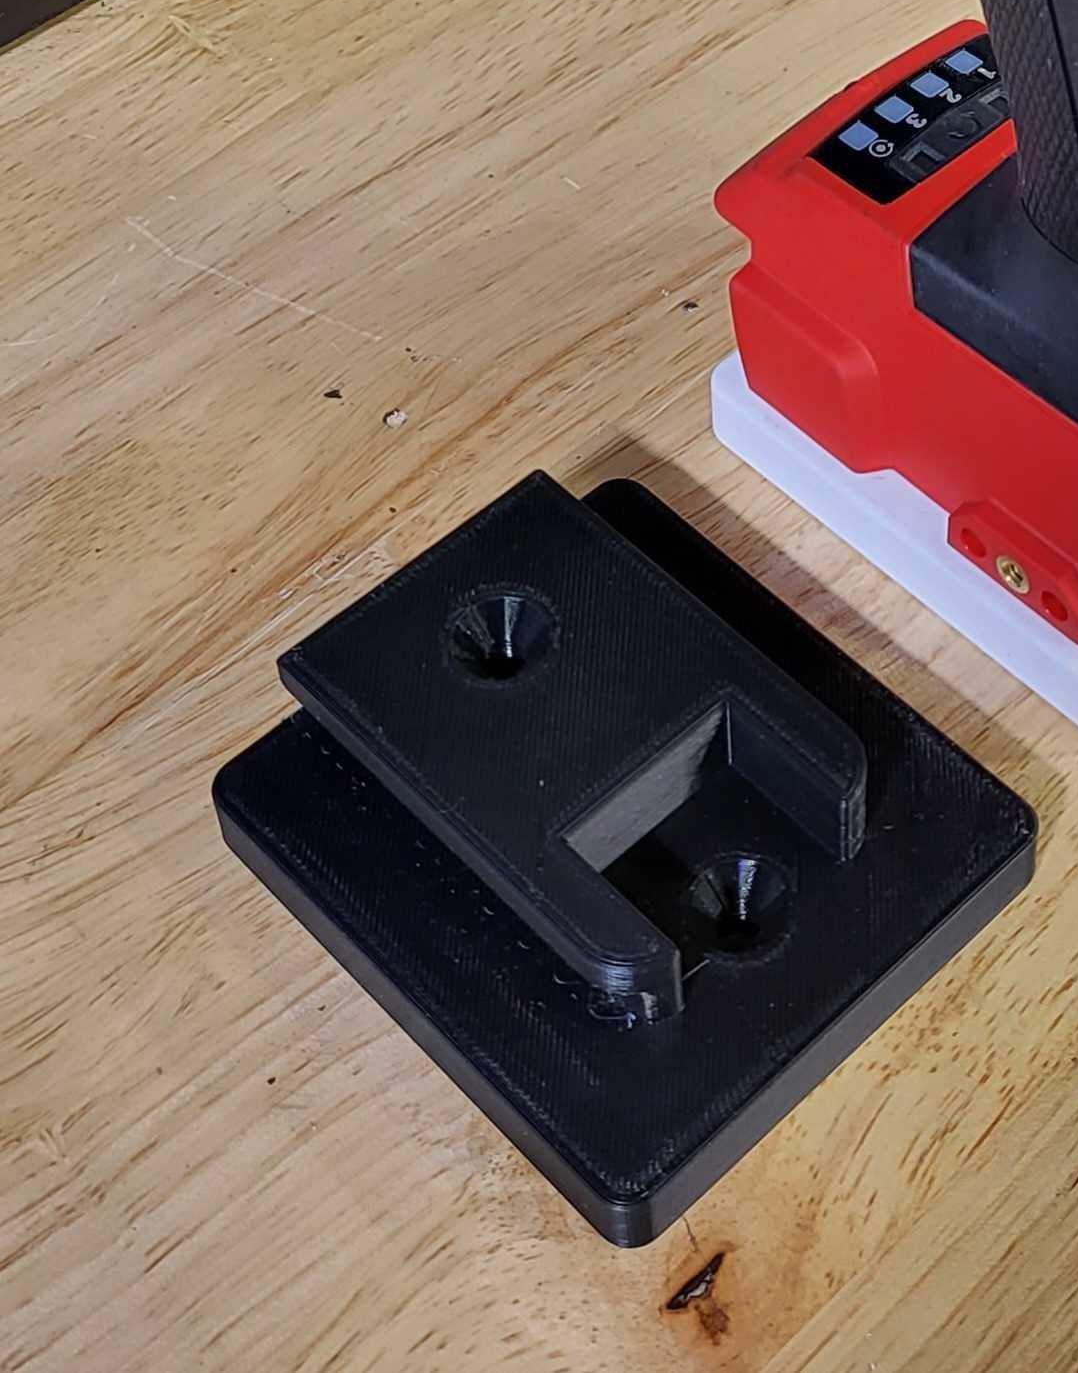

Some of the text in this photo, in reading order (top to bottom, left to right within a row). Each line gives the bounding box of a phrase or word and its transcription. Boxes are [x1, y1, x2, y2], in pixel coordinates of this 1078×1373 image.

[977, 67, 997, 80] 1
[939, 87, 962, 104] 2
[905, 113, 928, 129] 3
